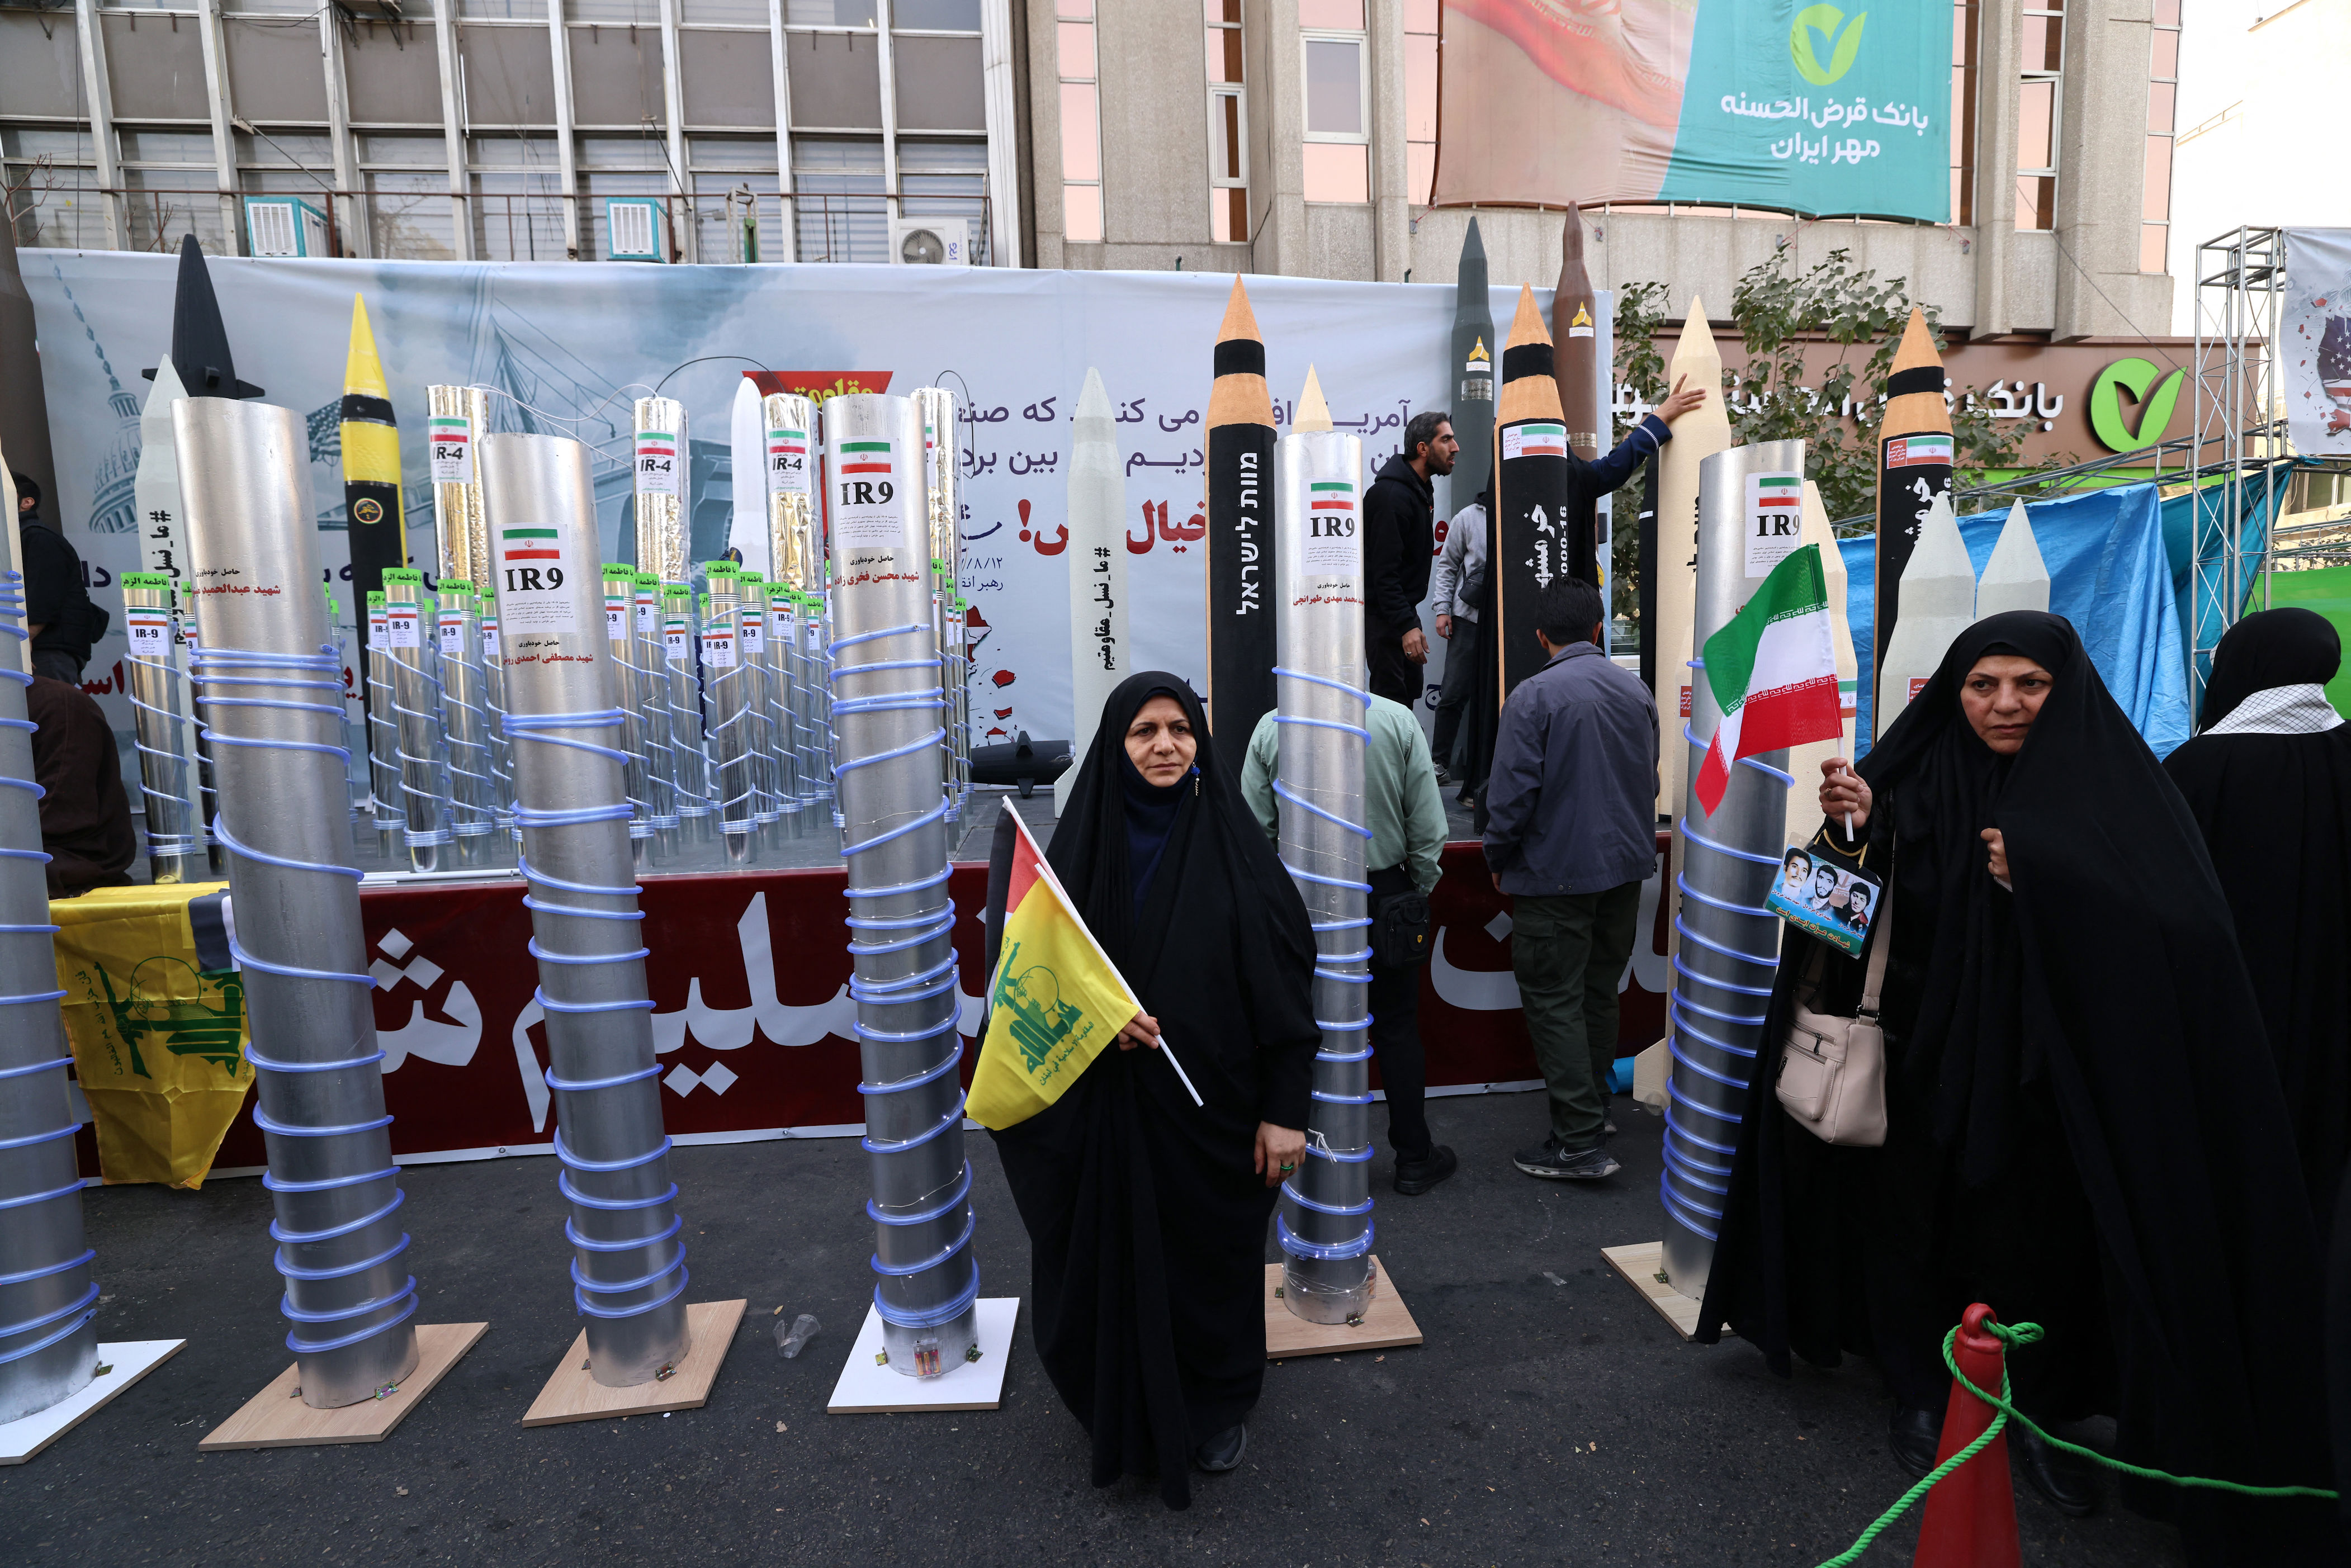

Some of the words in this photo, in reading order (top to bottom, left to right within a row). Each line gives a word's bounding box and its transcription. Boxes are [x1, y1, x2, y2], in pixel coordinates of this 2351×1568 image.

[1720, 92, 1808, 120] الحسنه
[1811, 97, 1867, 128] قرض
[1872, 102, 1928, 135] بانک
[1770, 132, 1827, 164] ایران
[1830, 138, 1880, 164] مهر
[1023, 396, 1056, 422] که
[1966, 378, 2064, 432] بانک
[1158, 409, 1200, 433] می
[640, 459, 671, 472] IR-4
[773, 457, 802, 471] IR-4
[1009, 449, 1058, 475] بین
[1240, 452, 1258, 509] מוות
[839, 481, 894, 505] IR9
[1310, 517, 1355, 537] IR9
[1756, 514, 1800, 537] IR9
[850, 556, 875, 566] خودباوری
[1234, 517, 1259, 615] לישראל
[144, 577, 167, 586] فاطمه
[505, 567, 564, 591] IR9
[834, 575, 846, 586] زاده
[847, 571, 870, 585] فخری
[872, 573, 900, 584] محسن
[901, 571, 919, 582] شهید
[202, 584, 250, 596] عبدالحمید
[254, 585, 281, 596] شهید
[977, 579, 1004, 591] رهبر
[1293, 594, 1322, 606] طهرانچی
[1324, 595, 1342, 604] مهدی
[637, 607, 646, 615] -9
[392, 621, 410, 630] IR-9
[441, 627, 456, 636] IR-9
[135, 628, 158, 638] IR-9
[713, 641, 728, 650] IR-9
[514, 653, 540, 665] احمدی
[542, 653, 574, 664] مصطفی
[576, 653, 593, 663] شهید
[1776, 906, 1790, 917] است
